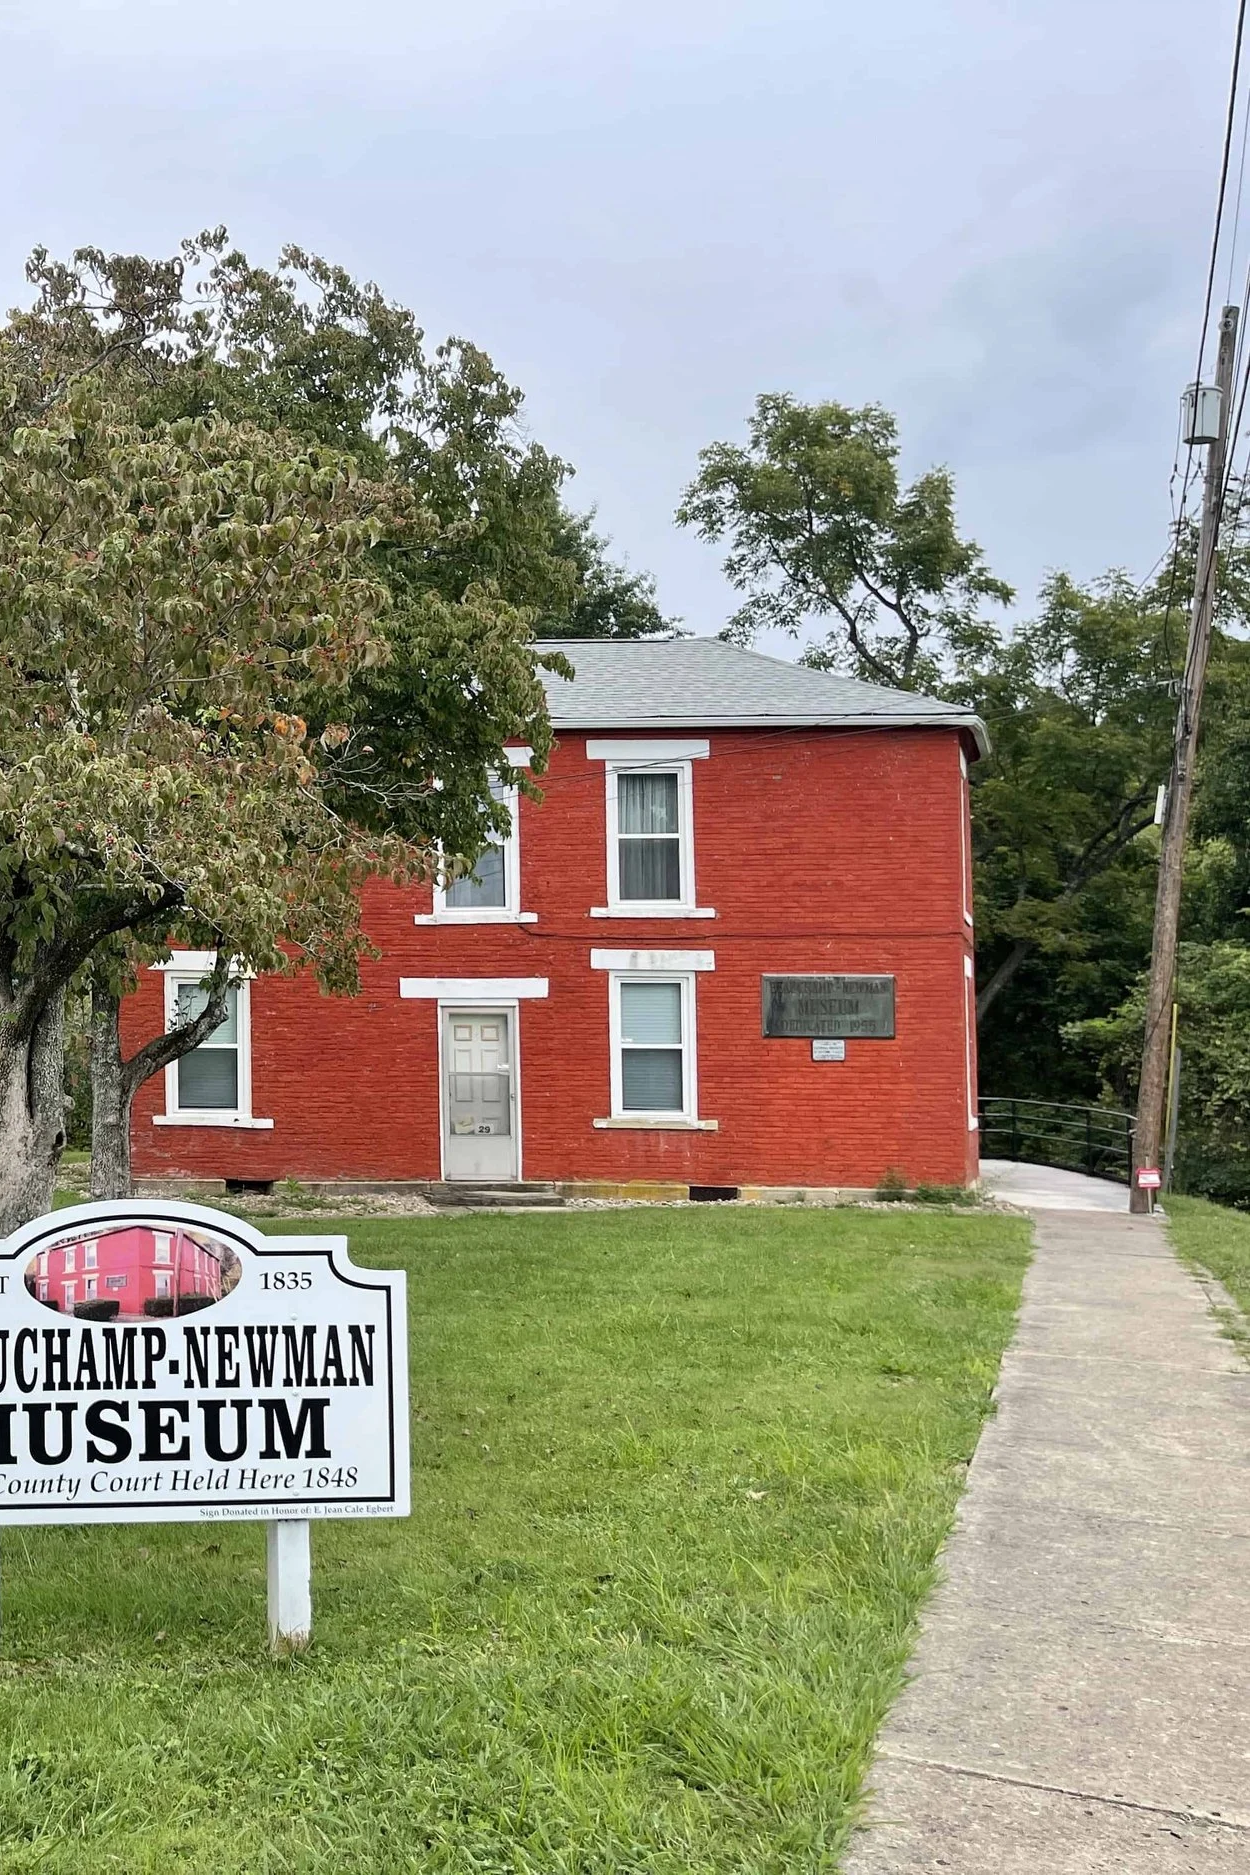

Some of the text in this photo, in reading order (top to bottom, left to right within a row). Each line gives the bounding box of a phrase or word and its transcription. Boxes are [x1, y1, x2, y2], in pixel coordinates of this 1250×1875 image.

[798, 999, 859, 1015] MUSEUM
[782, 1020, 841, 1032] DEDICATED
[478, 1125, 491, 1134] 29
[260, 1271, 312, 1290] 1835
[90, 1470, 163, 1491] Court
[170, 1467, 229, 1491] Held
[237, 1467, 295, 1490] Here
[303, 1466, 358, 1488] 1848
[200, 1508, 219, 1518] Sign
[222, 1507, 258, 1516] Donated
[261, 1507, 269, 1515] in
[271, 1506, 298, 1515] Honor
[324, 1505, 343, 1515] Jean
[344, 1505, 364, 1513] Cale
[366, 1504, 394, 1513] Egbert
